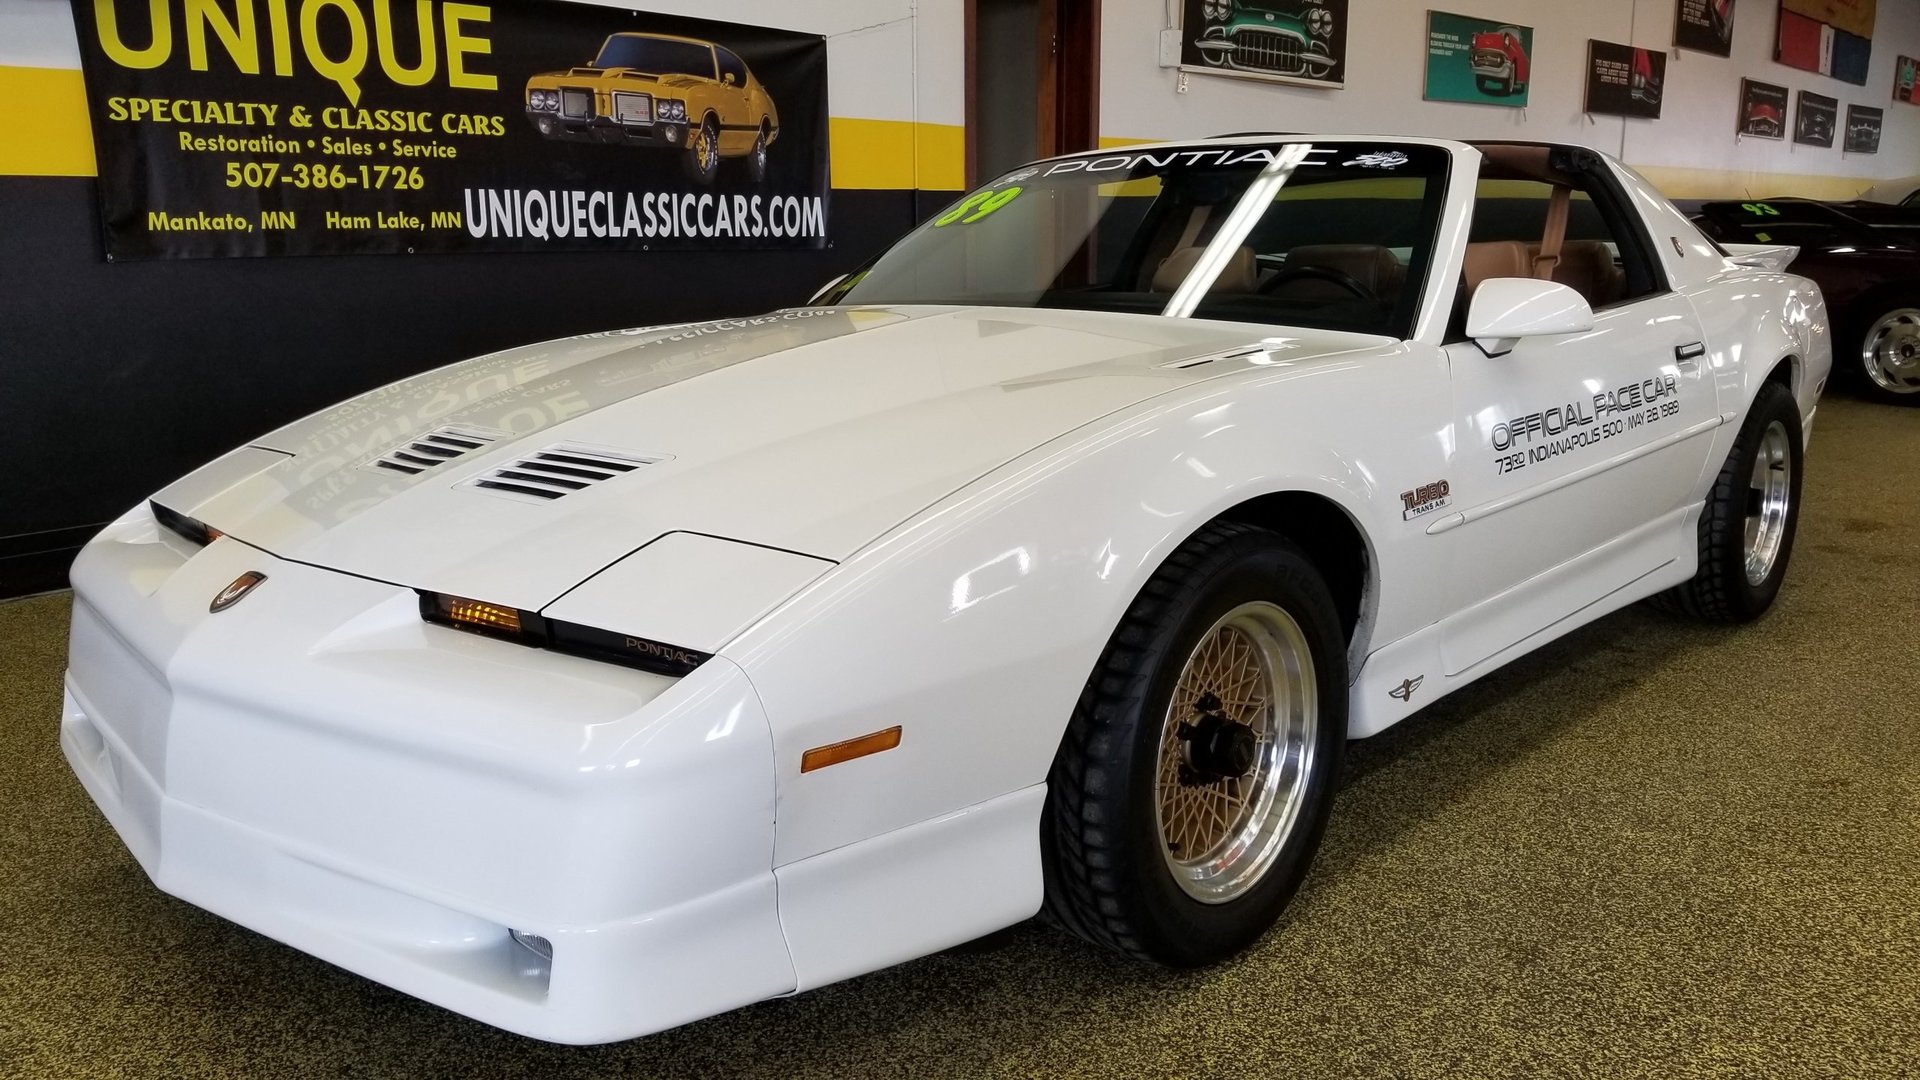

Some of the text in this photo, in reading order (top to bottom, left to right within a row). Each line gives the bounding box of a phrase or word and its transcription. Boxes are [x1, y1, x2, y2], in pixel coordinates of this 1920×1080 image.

[94, 0, 499, 107] UNIQUE
[108, 97, 505, 136] SPECIALTY & CLASSIC CARS
[179, 131, 457, 158] Restoration Sales Service
[226, 162, 425, 190] 507-386-1726
[1043, 149, 1338, 177] PONTIAC
[148, 211, 462, 233] Mankato, MN Ham Lake, MN
[464, 188, 825, 241] UNIQUECLASSICCARS.COM
[935, 187, 1023, 228] 89
[1741, 203, 1780, 216] 93
[1491, 373, 1677, 452] OFFICIAL PACE CAR
[1495, 451, 1526, 475] 73RD
[1528, 427, 1600, 464] INDIANAPOLIS
[1602, 419, 1623, 438] 500
[1628, 411, 1646, 430] MAY
[1660, 400, 1680, 417] 1989
[1400, 479, 1450, 511] TURBO
[1412, 498, 1446, 516] TRANS AM
[626, 636, 698, 666] PONTIAC
